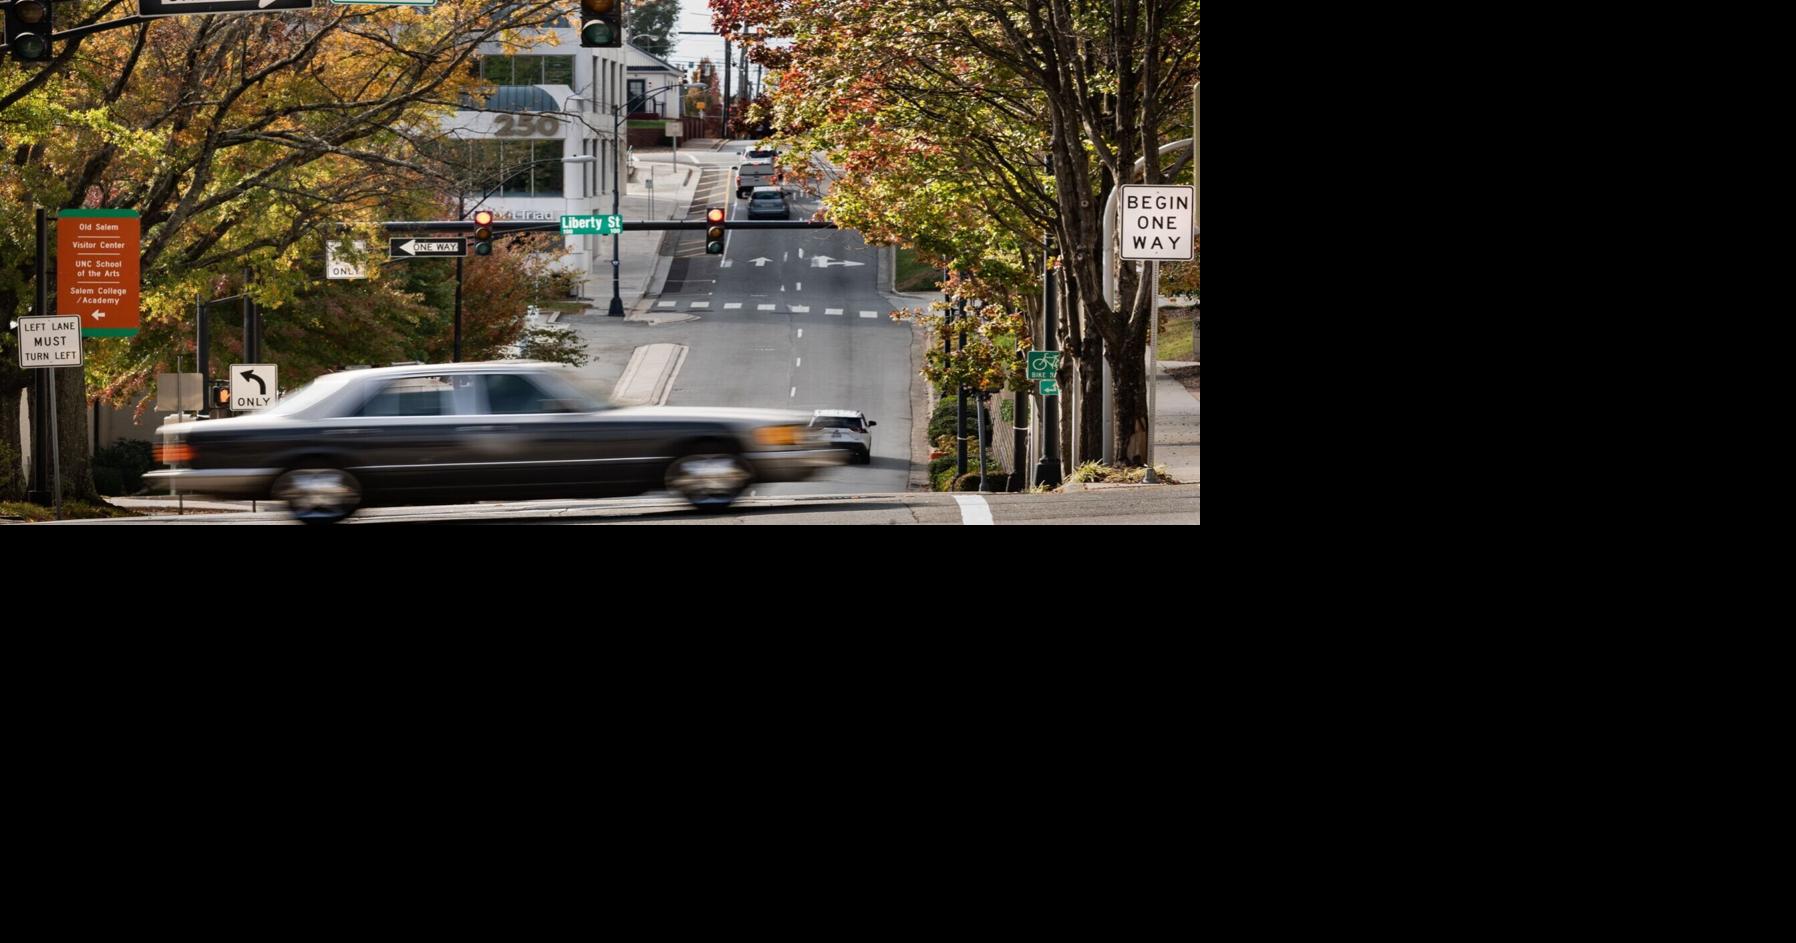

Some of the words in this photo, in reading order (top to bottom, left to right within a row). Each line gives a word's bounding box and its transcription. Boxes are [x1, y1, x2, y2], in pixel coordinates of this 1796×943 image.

[494, 114, 559, 136] 250
[1127, 195, 1188, 210] BEGIN
[79, 223, 92, 231] Old
[95, 223, 119, 231] Salem
[562, 216, 603, 231] Liberty
[608, 216, 621, 228] St
[1137, 215, 1177, 230] ONE
[72, 241, 96, 249] Visitor
[100, 241, 125, 249] Center
[412, 243, 433, 251] ONE
[436, 243, 457, 251] WAY
[1133, 235, 1181, 250] WAY
[75, 260, 92, 268] UNC
[96, 260, 122, 268] School
[70, 287, 94, 295] Salem
[97, 287, 127, 296] College
[76, 297, 120, 305] /Academy
[24, 322, 46, 332] LEFT
[52, 321, 76, 331] LANE
[34, 336, 67, 347] MUST
[25, 352, 50, 361] TURN
[54, 351, 77, 360] LEFT
[1031, 371, 1046, 379] BIKE
[237, 397, 271, 407] ONLY
